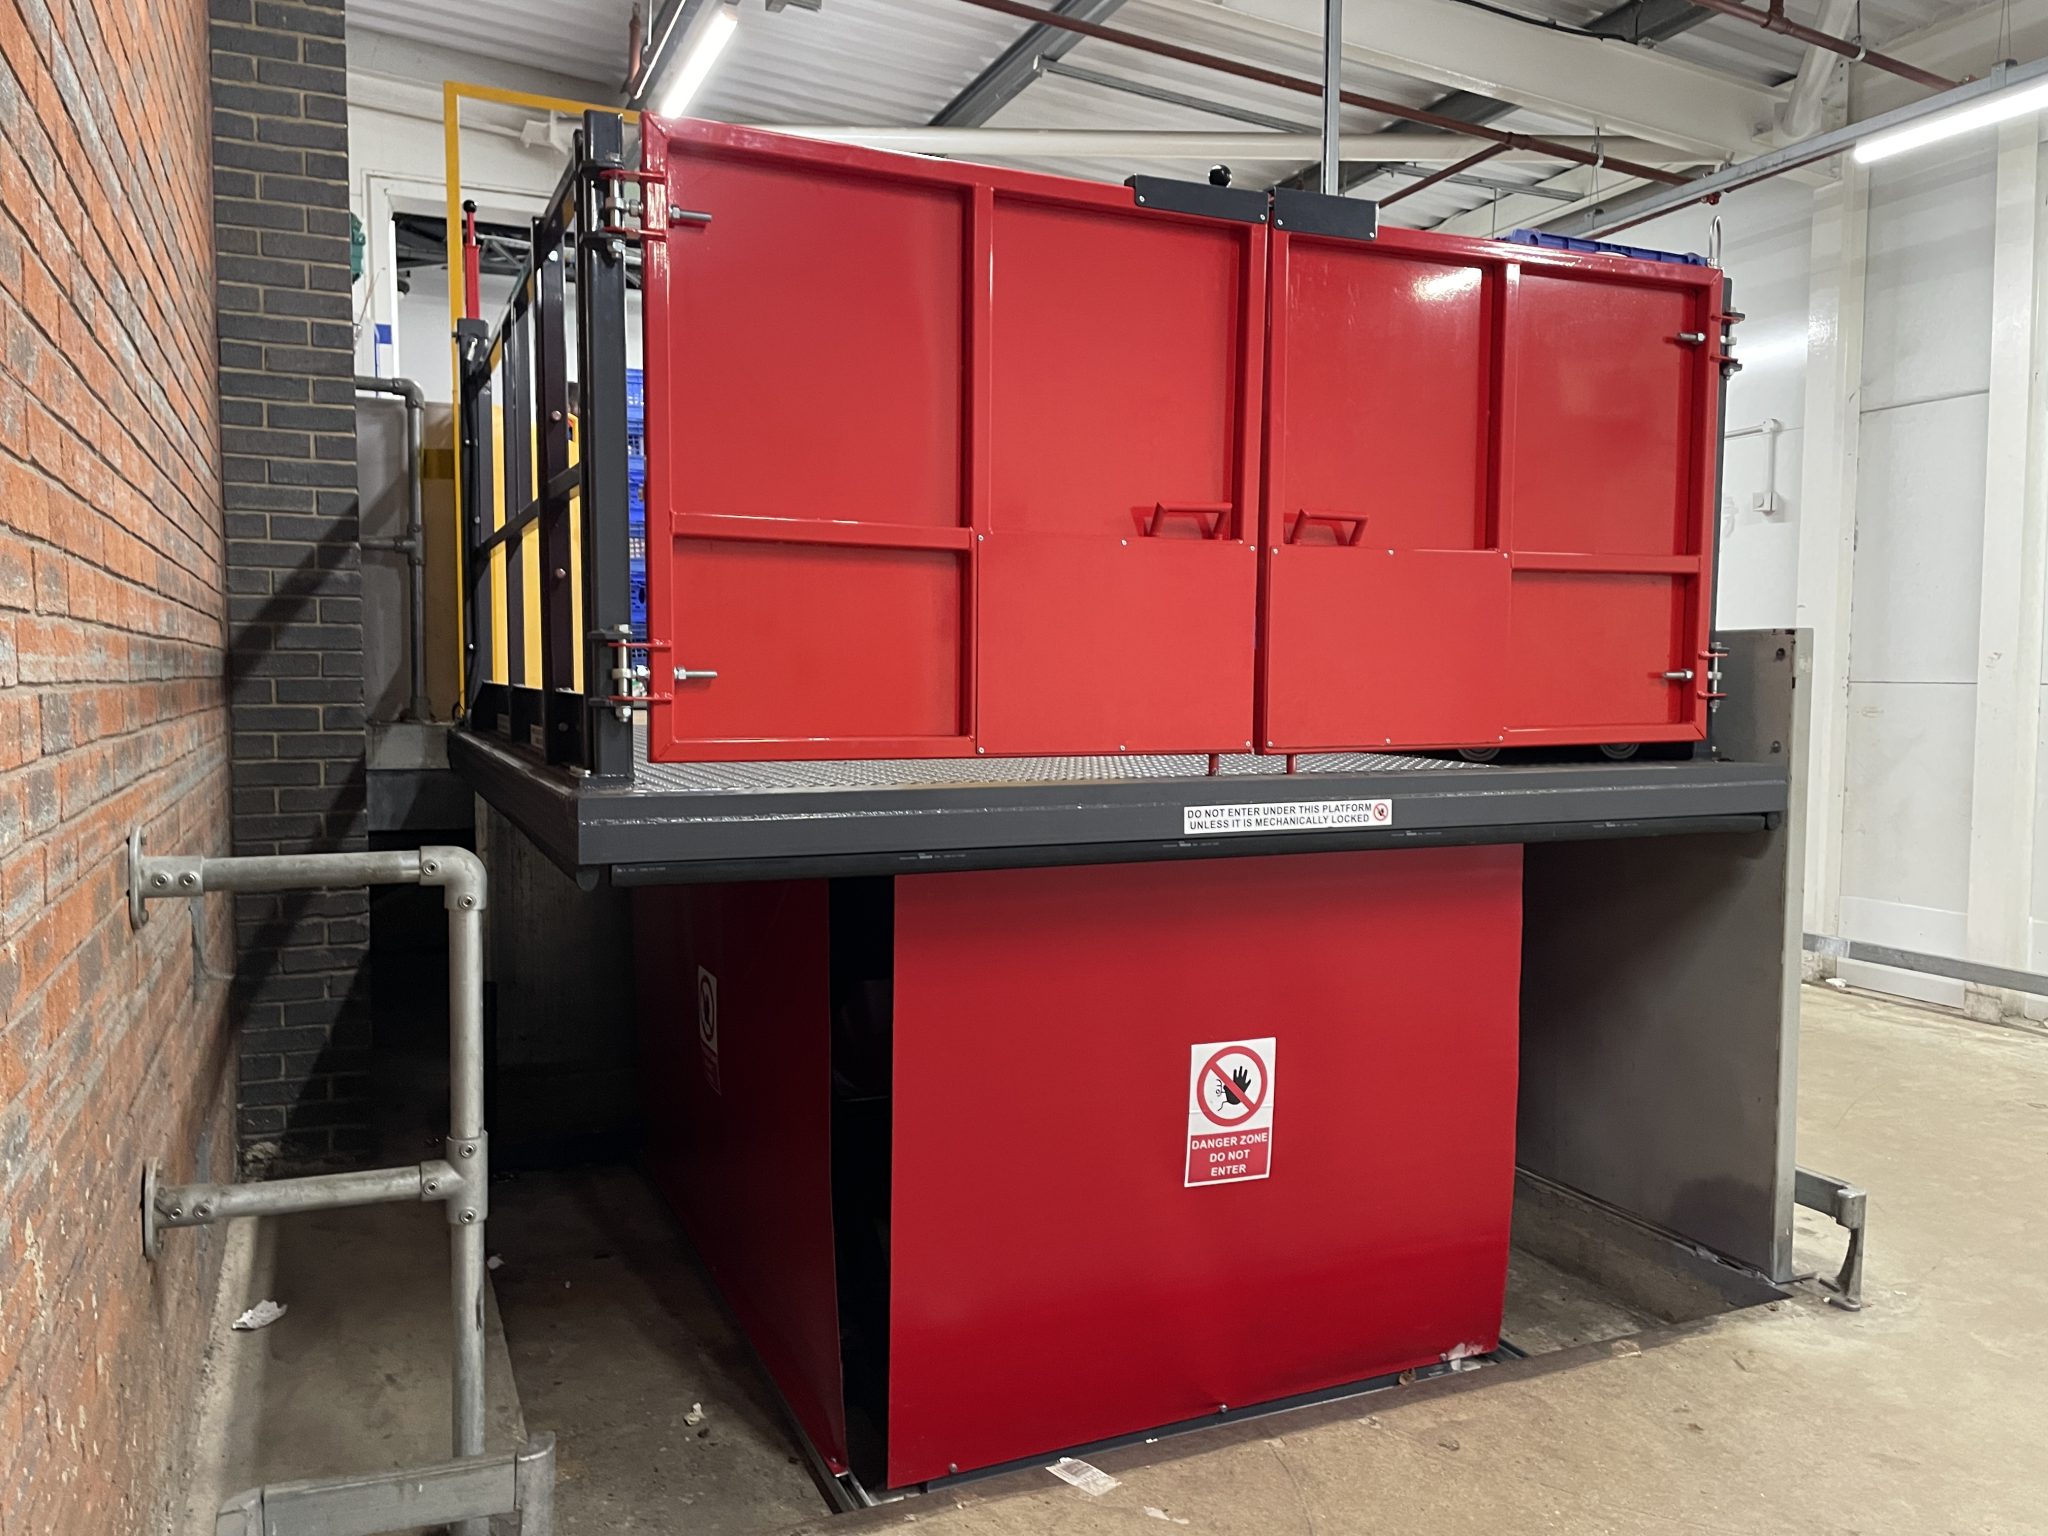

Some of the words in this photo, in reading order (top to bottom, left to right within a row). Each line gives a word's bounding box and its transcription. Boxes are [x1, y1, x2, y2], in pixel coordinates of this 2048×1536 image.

[1187, 810, 1202, 819] DO
[1205, 808, 1225, 818] NOT
[1228, 807, 1260, 817] ENTER
[1263, 805, 1296, 816] UNDER
[1299, 805, 1320, 814] THIS
[1322, 803, 1372, 813] PLATFORM
[1190, 820, 1229, 830] UNLESS
[1232, 819, 1241, 828] IT
[1243, 818, 1253, 827] IS
[1255, 815, 1329, 826] MECHANICALLY
[1331, 814, 1370, 824] LOCKED
[1192, 1136, 1238, 1150] DANGER
[1240, 1132, 1268, 1146] ZONE
[1210, 1152, 1226, 1163] DO
[1228, 1149, 1250, 1161] NOT
[1210, 1164, 1247, 1177] ENTER
